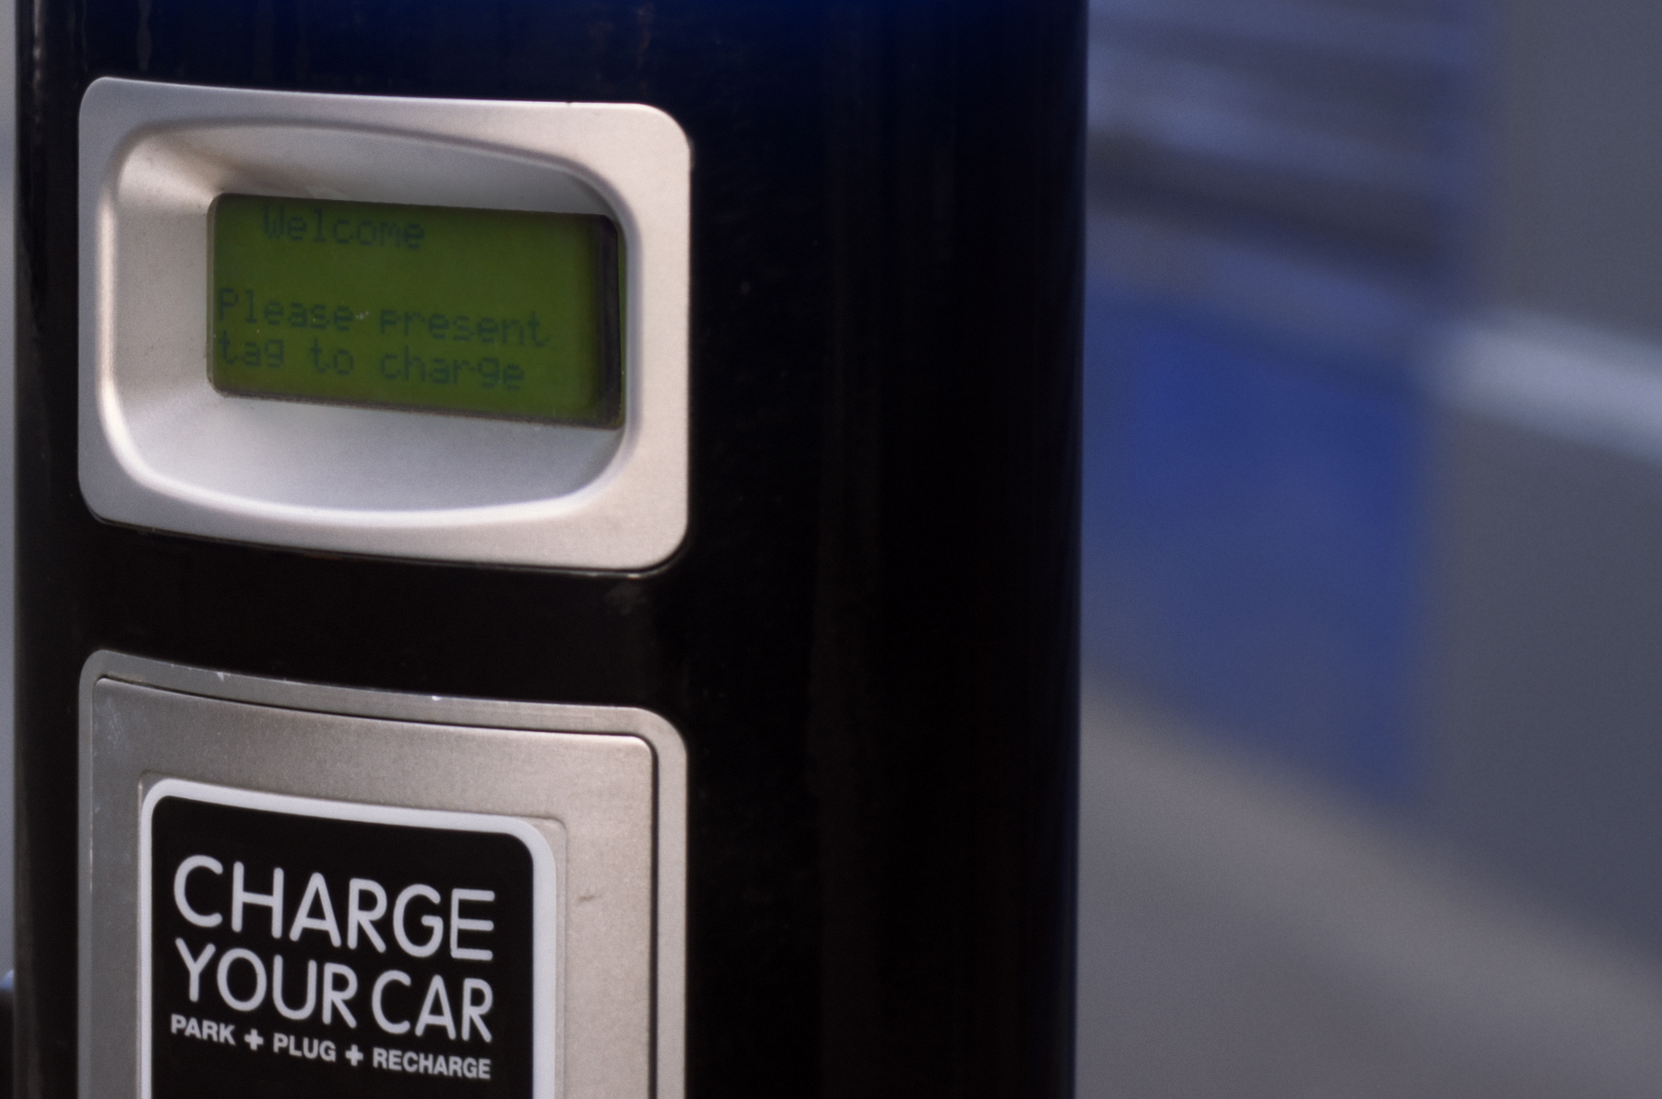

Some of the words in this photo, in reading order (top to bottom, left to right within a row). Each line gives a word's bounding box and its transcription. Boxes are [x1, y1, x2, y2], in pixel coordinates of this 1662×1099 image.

[262, 205, 426, 250] Welcome
[217, 288, 355, 332] Please
[218, 330, 285, 369] tag
[310, 336, 355, 377] to
[379, 346, 526, 391] charge
[173, 854, 496, 961] CHARGE
[175, 937, 358, 1029] YOUR
[371, 969, 493, 1043] CAR
[170, 1013, 236, 1046] PARK
[273, 1032, 337, 1063] PLUG
[372, 1047, 492, 1080] RECHARGE
